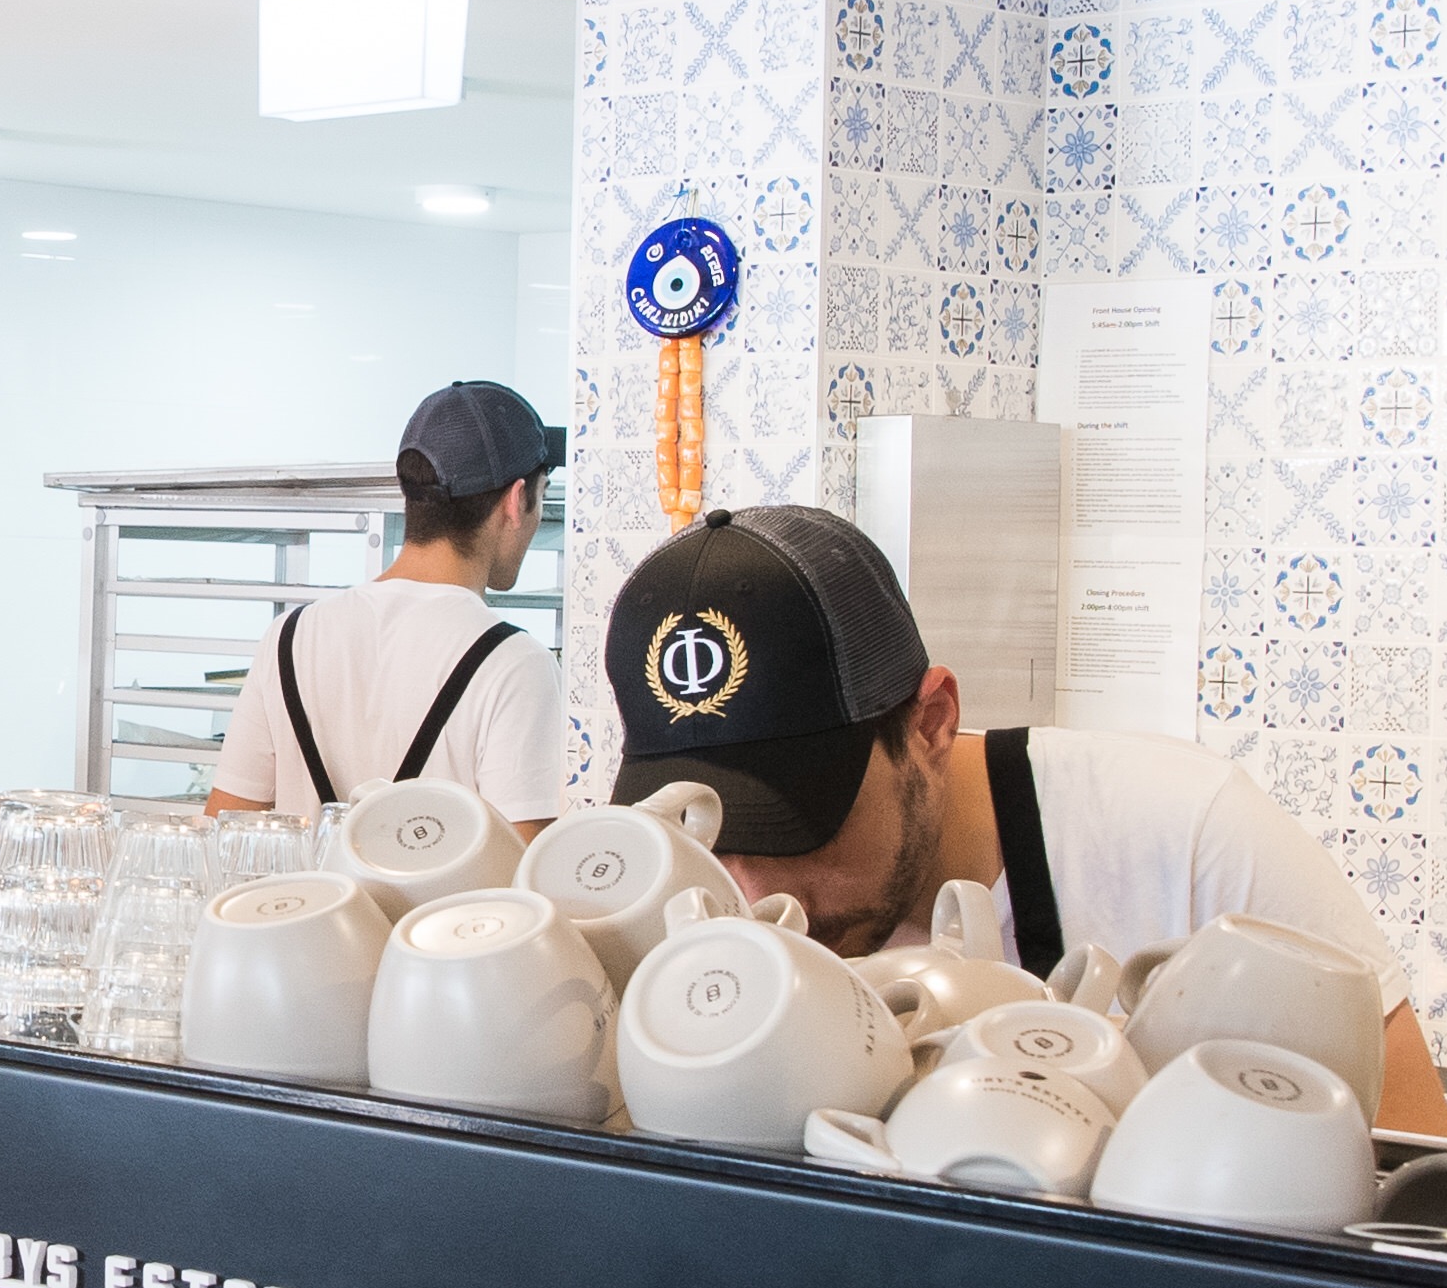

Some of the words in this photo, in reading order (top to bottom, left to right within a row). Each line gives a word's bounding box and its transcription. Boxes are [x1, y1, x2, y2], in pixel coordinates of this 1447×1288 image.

[1092, 306, 1110, 315] Front
[1111, 306, 1132, 314] House
[1133, 305, 1161, 315] Opening
[1076, 421, 1100, 431] During
[1100, 422, 1112, 430] the
[1113, 421, 1129, 430] shift
[1085, 588, 1110, 598] Closing
